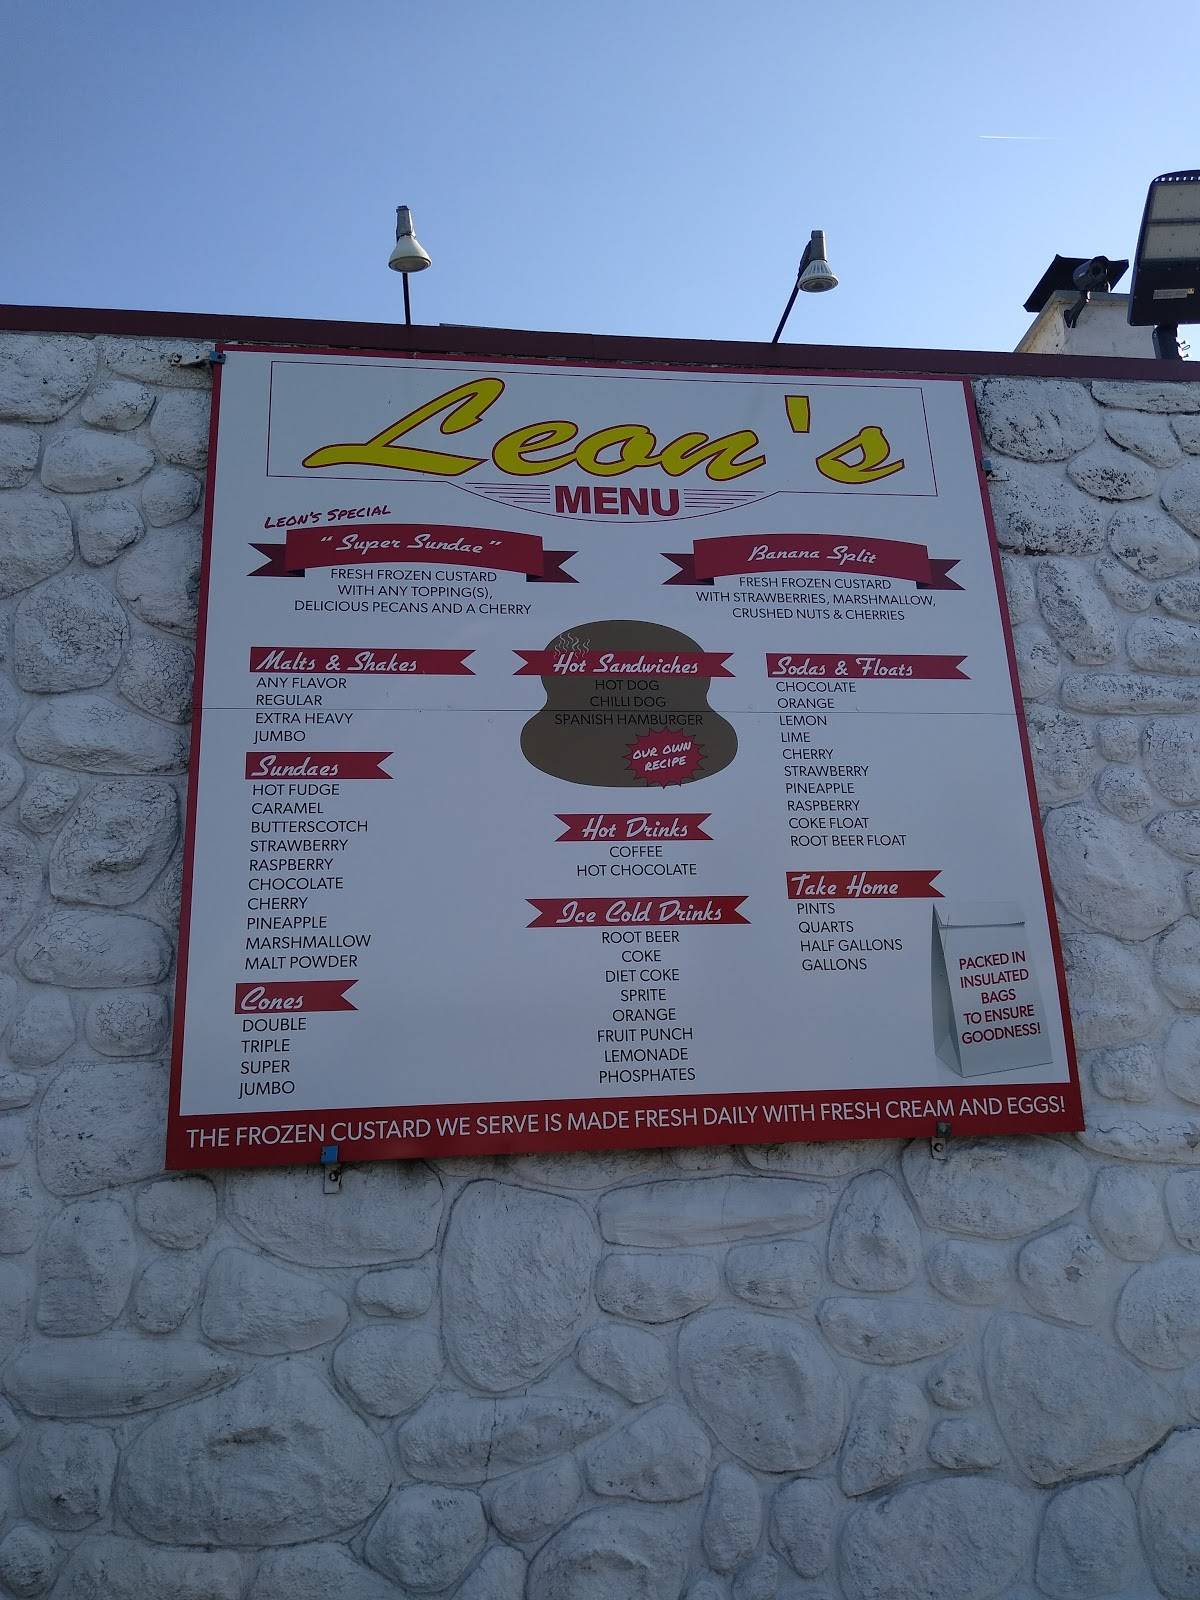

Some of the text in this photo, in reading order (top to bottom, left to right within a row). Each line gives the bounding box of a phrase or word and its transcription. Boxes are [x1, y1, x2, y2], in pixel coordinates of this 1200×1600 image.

[302, 377, 905, 484] Leon's
[555, 485, 679, 516] MENU
[748, 545, 877, 565] Banana Split
[330, 568, 498, 583] FRESH FROZEN CUSTARD
[738, 576, 892, 590] FRESH FROZEN CUSTARD
[337, 584, 493, 600] WITH ANY TOPPING(S),
[695, 591, 937, 607] WITH STRAWBERRIES, MARSHMALLOW,
[293, 600, 532, 616] DELICIOUS PECANS AND A CHERRY
[732, 607, 906, 621] CRUSHED NUTS & CHERRIES
[256, 650, 417, 671] Malts & Shakes
[553, 652, 698, 674] Hot Sandwiches
[772, 656, 913, 676] Sodas & Floats
[255, 677, 348, 690] ANY FLAVOR
[595, 679, 660, 691] HOT DOG
[775, 681, 857, 693] CHOCOLATE
[255, 694, 323, 707] REGULAR
[589, 696, 667, 708] CHILLI DOG
[777, 697, 835, 709] ORANGE
[255, 712, 354, 725] EXTRA HEAVY
[554, 713, 704, 726] SPANISH HAMBURGER
[779, 715, 828, 726] LEMON
[252, 730, 307, 745] JUMBO
[780, 731, 811, 743] LIME
[632, 741, 692, 761] OUR OWN
[781, 748, 834, 760] CHERRY
[251, 755, 339, 777] Sundaes
[645, 757, 686, 771] RECIPE
[783, 765, 869, 777] STRAWBERRY
[252, 783, 340, 797] HOT FUDGE
[785, 783, 855, 794] PINEAPPLE
[250, 802, 324, 815] CARAMEL
[786, 800, 861, 812] RASPBERRY
[250, 820, 369, 834] BUTTERSCOTCH
[582, 816, 688, 840] Hot Drinks
[788, 817, 870, 830] COKE FLOAT
[250, 839, 349, 853] STRAWBERRY
[790, 834, 907, 847] ROOT BEER FLOAT
[609, 845, 663, 859] COFFEE
[248, 858, 334, 872] RASPBERRY
[576, 863, 697, 877] HOT CHOCOLATE
[248, 877, 344, 891] CHOCOLATE
[792, 872, 898, 897] Take Home
[247, 897, 308, 911] CHERRY
[796, 902, 836, 915] PINTS
[556, 901, 721, 923] Ice Cold Drinks
[246, 916, 328, 930] PINEAPPLE
[798, 920, 855, 934] QUARTS
[246, 935, 371, 950] MARSHMALLOW
[601, 930, 680, 944] ROOT BEER
[799, 938, 903, 953] HALF GALLONS
[244, 955, 358, 970] MALT POWDER
[621, 949, 662, 963] COKE
[959, 950, 1026, 970] PACKED IN
[801, 957, 868, 972] GALLONS
[605, 968, 680, 983] DIET COKE
[960, 968, 1028, 988] INSULATED
[240, 987, 304, 1011] Cones
[620, 988, 667, 1002] SPRITE
[981, 989, 1016, 1004] BAGS
[613, 1008, 676, 1022] ORANGE
[963, 1005, 1034, 1026] TO ENSURE
[243, 1018, 306, 1032] DOUBLE
[597, 1027, 694, 1043] FRUIT PUNCH
[962, 1024, 1041, 1044] GOODNESS!
[241, 1039, 290, 1053] TRIPLE
[605, 1048, 688, 1062] LEMONADE
[240, 1060, 290, 1074] SUPER
[600, 1068, 695, 1083] PHOSPHATES
[238, 1081, 295, 1099] JUMBO
[186, 1095, 1066, 1148] THE FROZEN CUSTARD WE SERVE IS MADE FRESH DAILY WITH FRESH CREAM AND EGGS!
